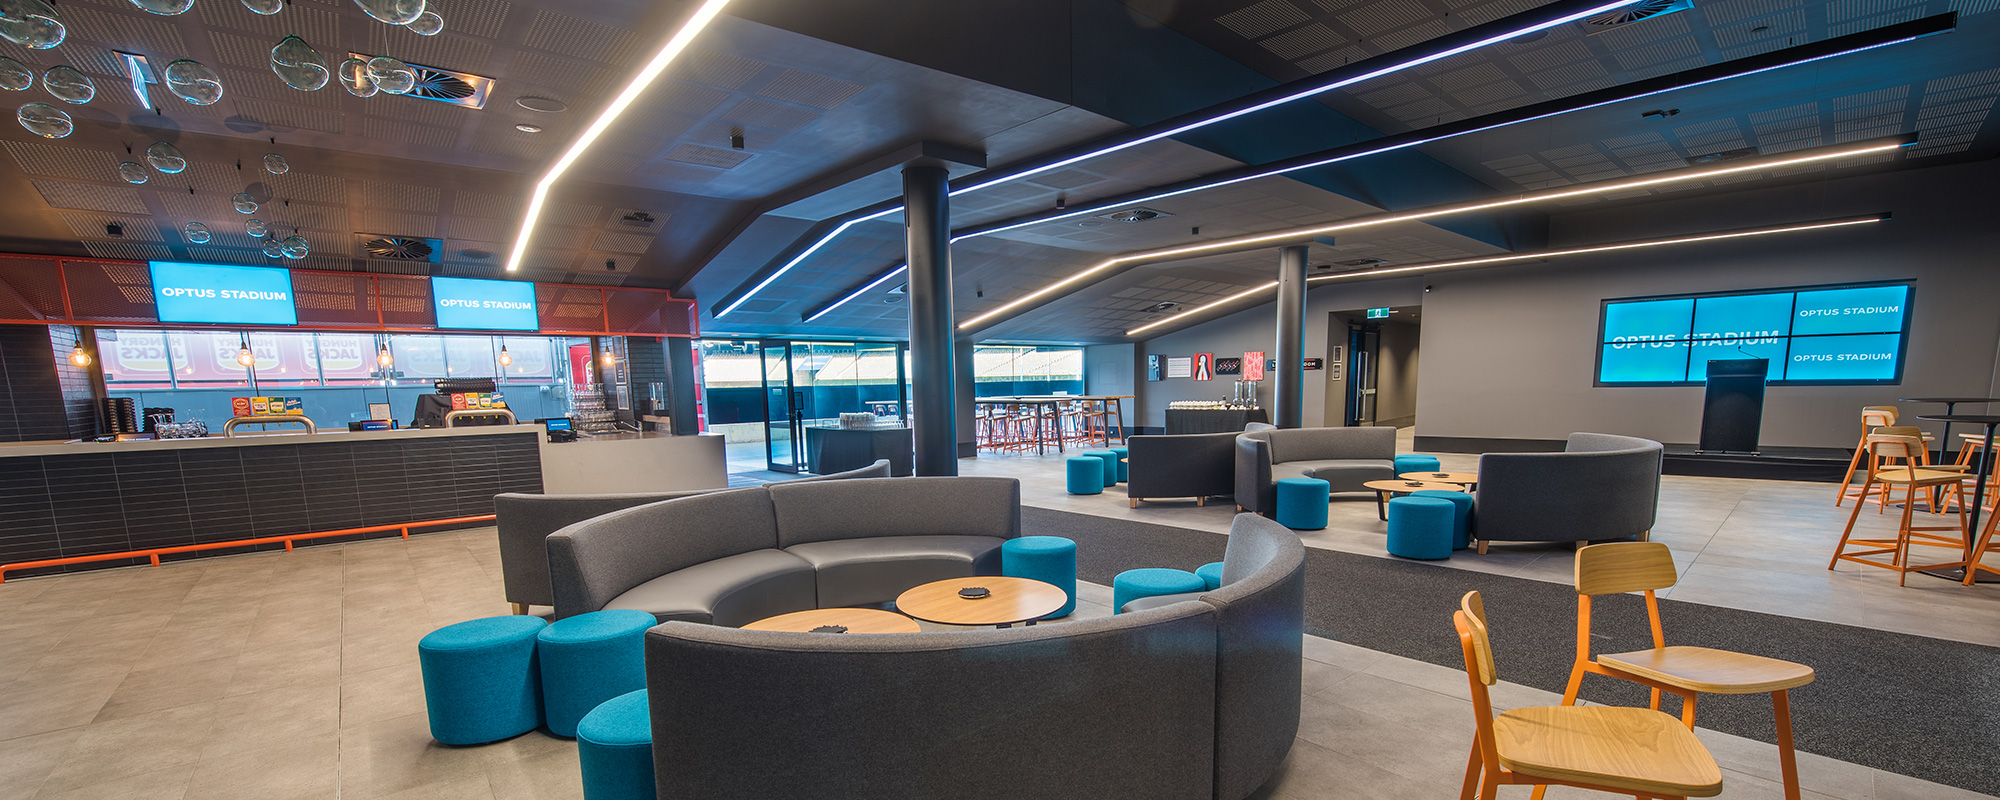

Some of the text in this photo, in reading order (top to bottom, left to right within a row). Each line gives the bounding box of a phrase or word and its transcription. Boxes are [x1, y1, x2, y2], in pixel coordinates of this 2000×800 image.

[161, 287, 288, 301] OPTUS STADIUM
[440, 298, 532, 311] OPTUS STADIUM
[1800, 305, 1899, 317] OPTUS STADIUM
[1612, 330, 1779, 349] OPTUS STADIUM
[1793, 353, 1892, 362] OPTUS STADIUM
